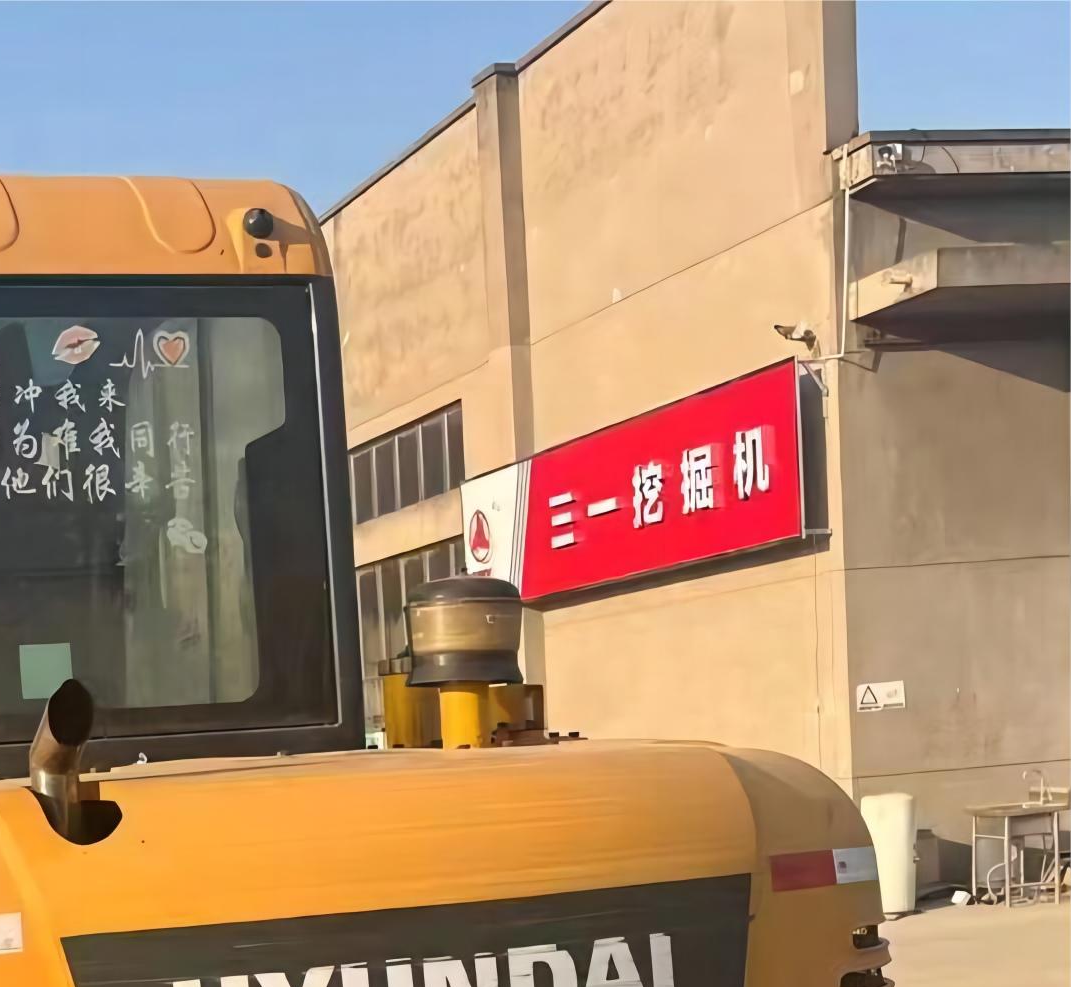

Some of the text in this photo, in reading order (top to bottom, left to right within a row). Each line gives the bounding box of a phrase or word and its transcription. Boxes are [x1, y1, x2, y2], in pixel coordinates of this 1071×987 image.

[548, 426, 770, 549] 三一挖掘机
